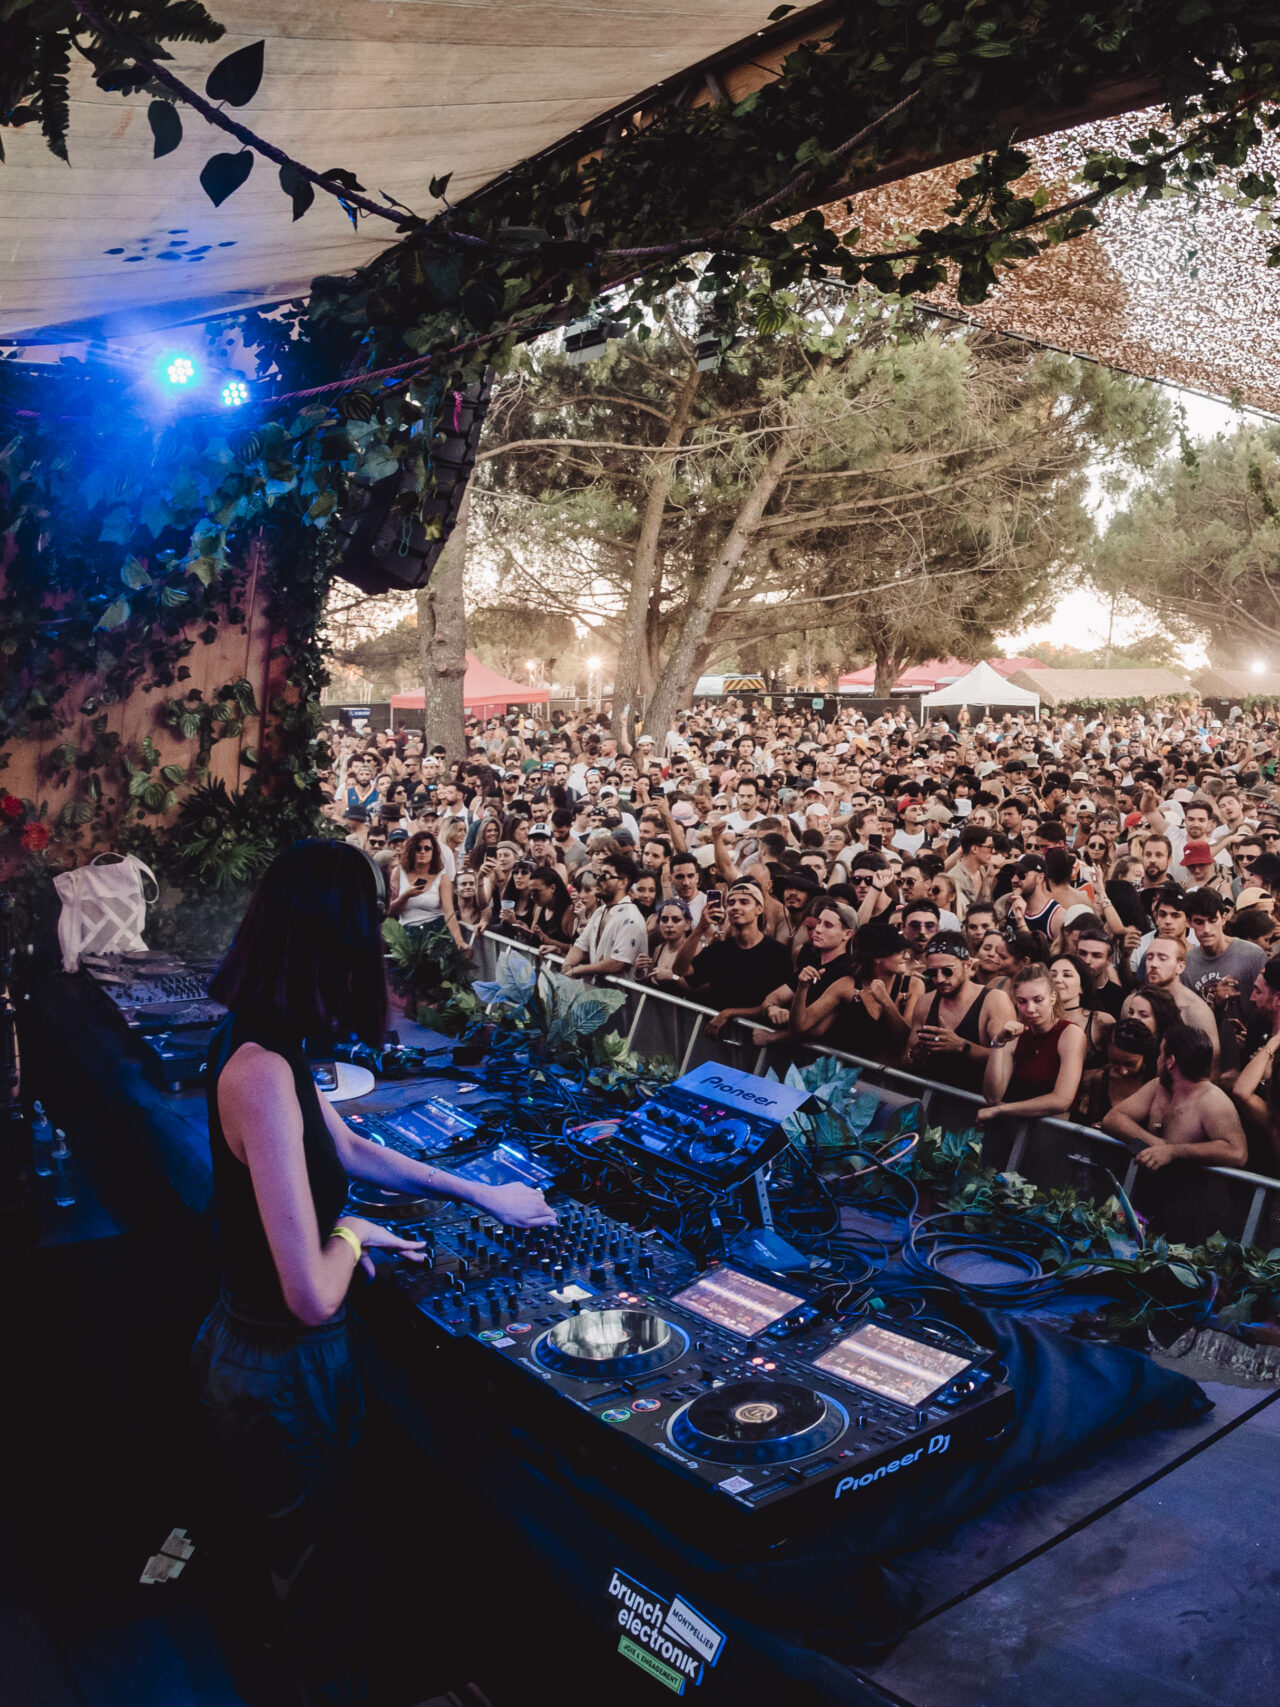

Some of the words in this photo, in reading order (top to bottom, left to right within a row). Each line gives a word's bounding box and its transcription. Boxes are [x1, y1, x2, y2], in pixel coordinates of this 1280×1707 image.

[700, 1075, 779, 1107] Pioneer
[834, 1447, 924, 1500] Pioneer
[608, 1572, 664, 1628] brunch
[671, 1608, 715, 1651] MONTPELLIER
[640, 1653, 680, 1686] ENGAGEMENT
